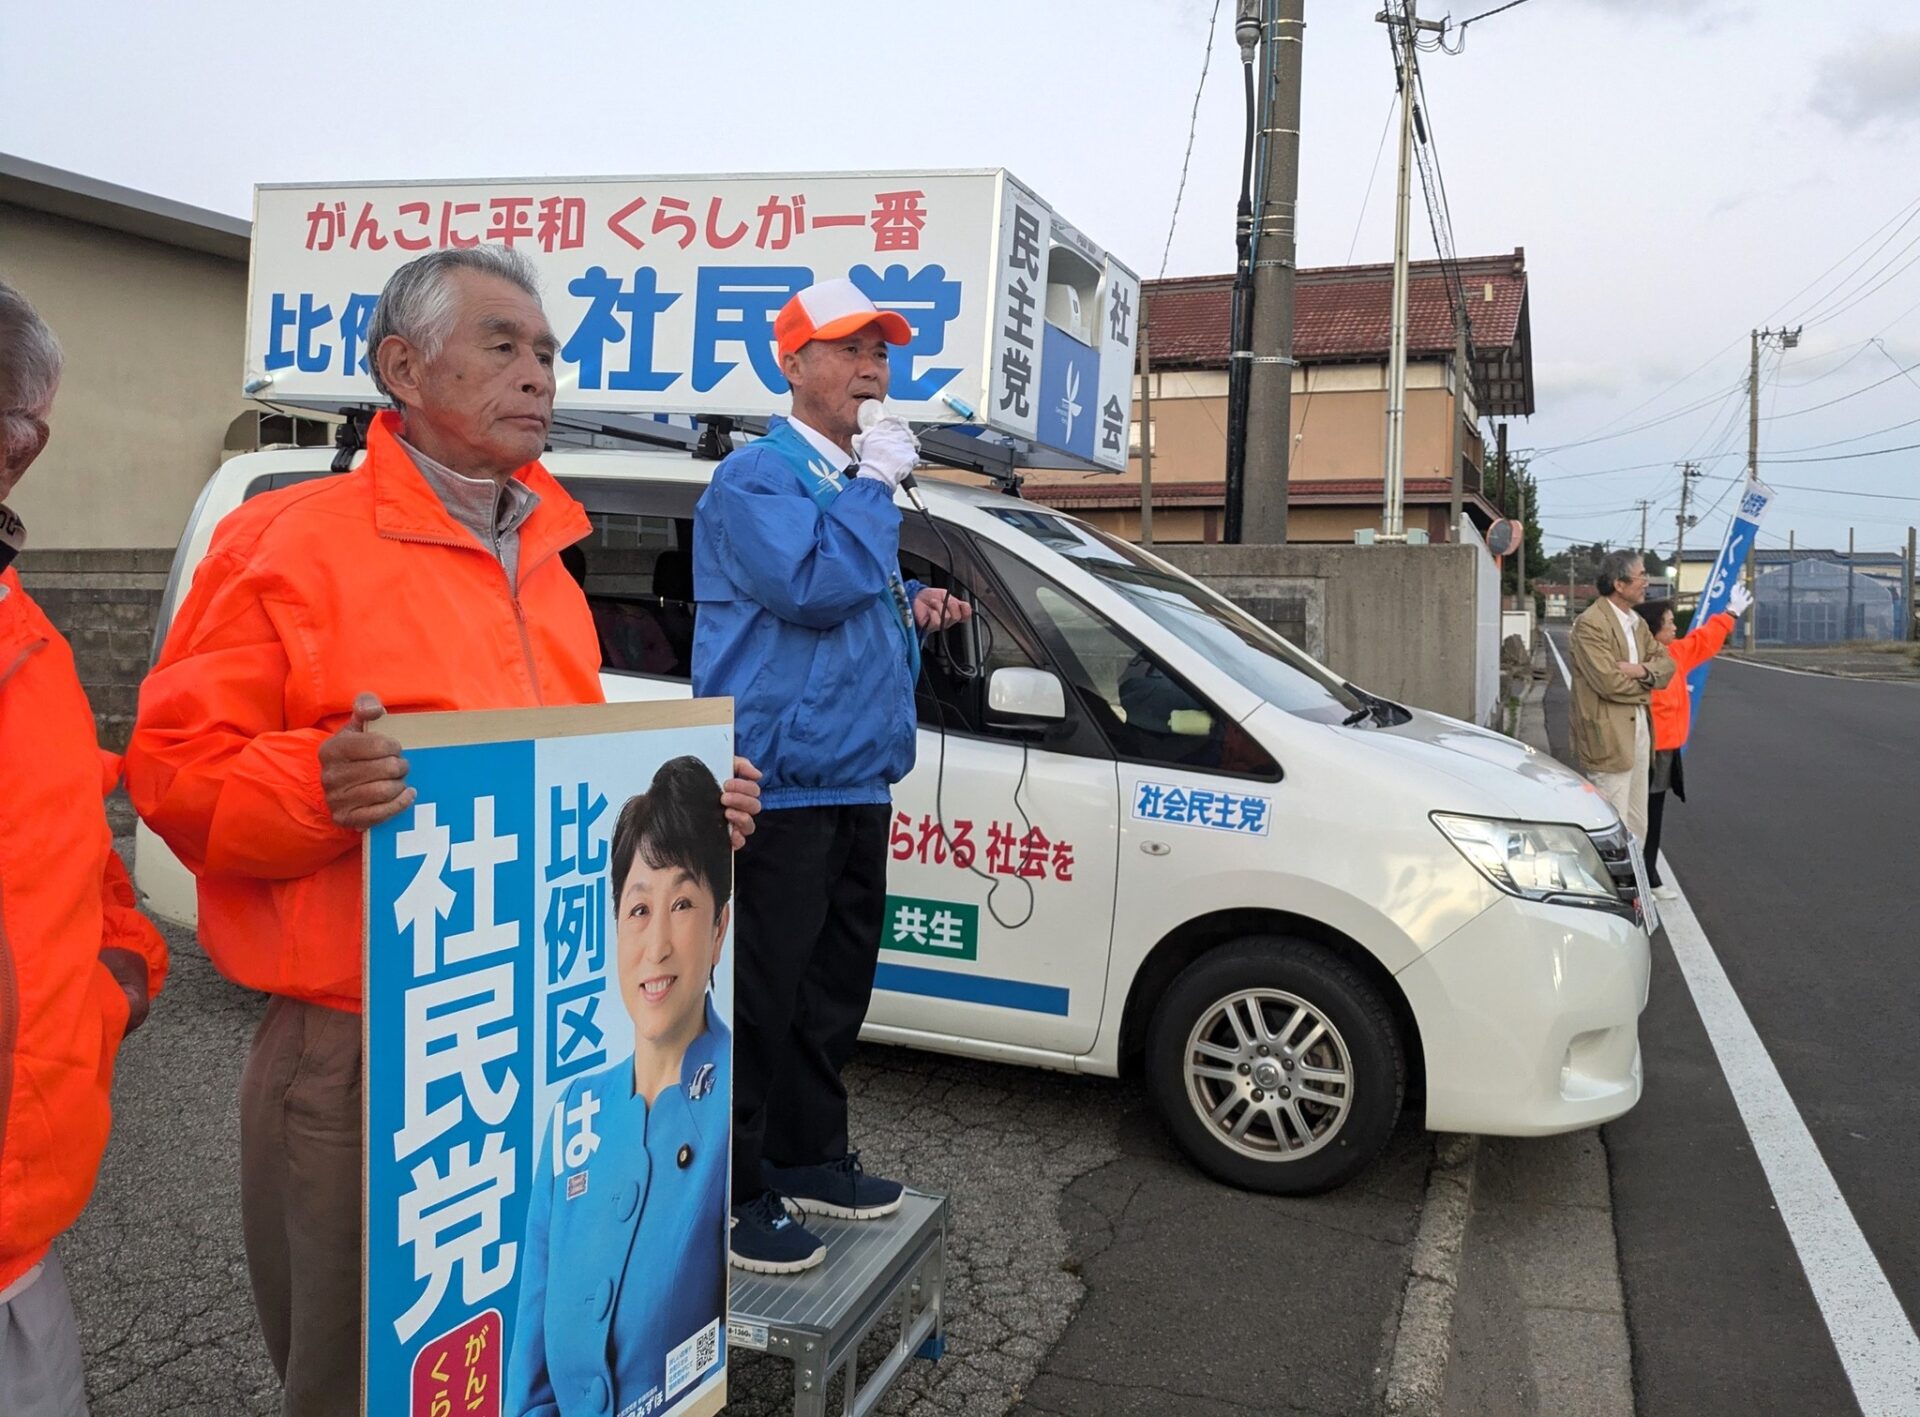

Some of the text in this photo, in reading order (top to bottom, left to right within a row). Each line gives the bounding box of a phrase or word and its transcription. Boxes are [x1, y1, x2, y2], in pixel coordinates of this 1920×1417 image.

[304, 189, 928, 253] がんこに平和 くらしが一番
[561, 263, 965, 403] 社民党
[999, 203, 1040, 419] 民主党
[985, 819, 1075, 882] 社会を
[1136, 783, 1268, 833] 社会民主党
[893, 905, 964, 950] 共生
[544, 781, 609, 1177] 比例区は
[393, 794, 520, 1345] 社民党
